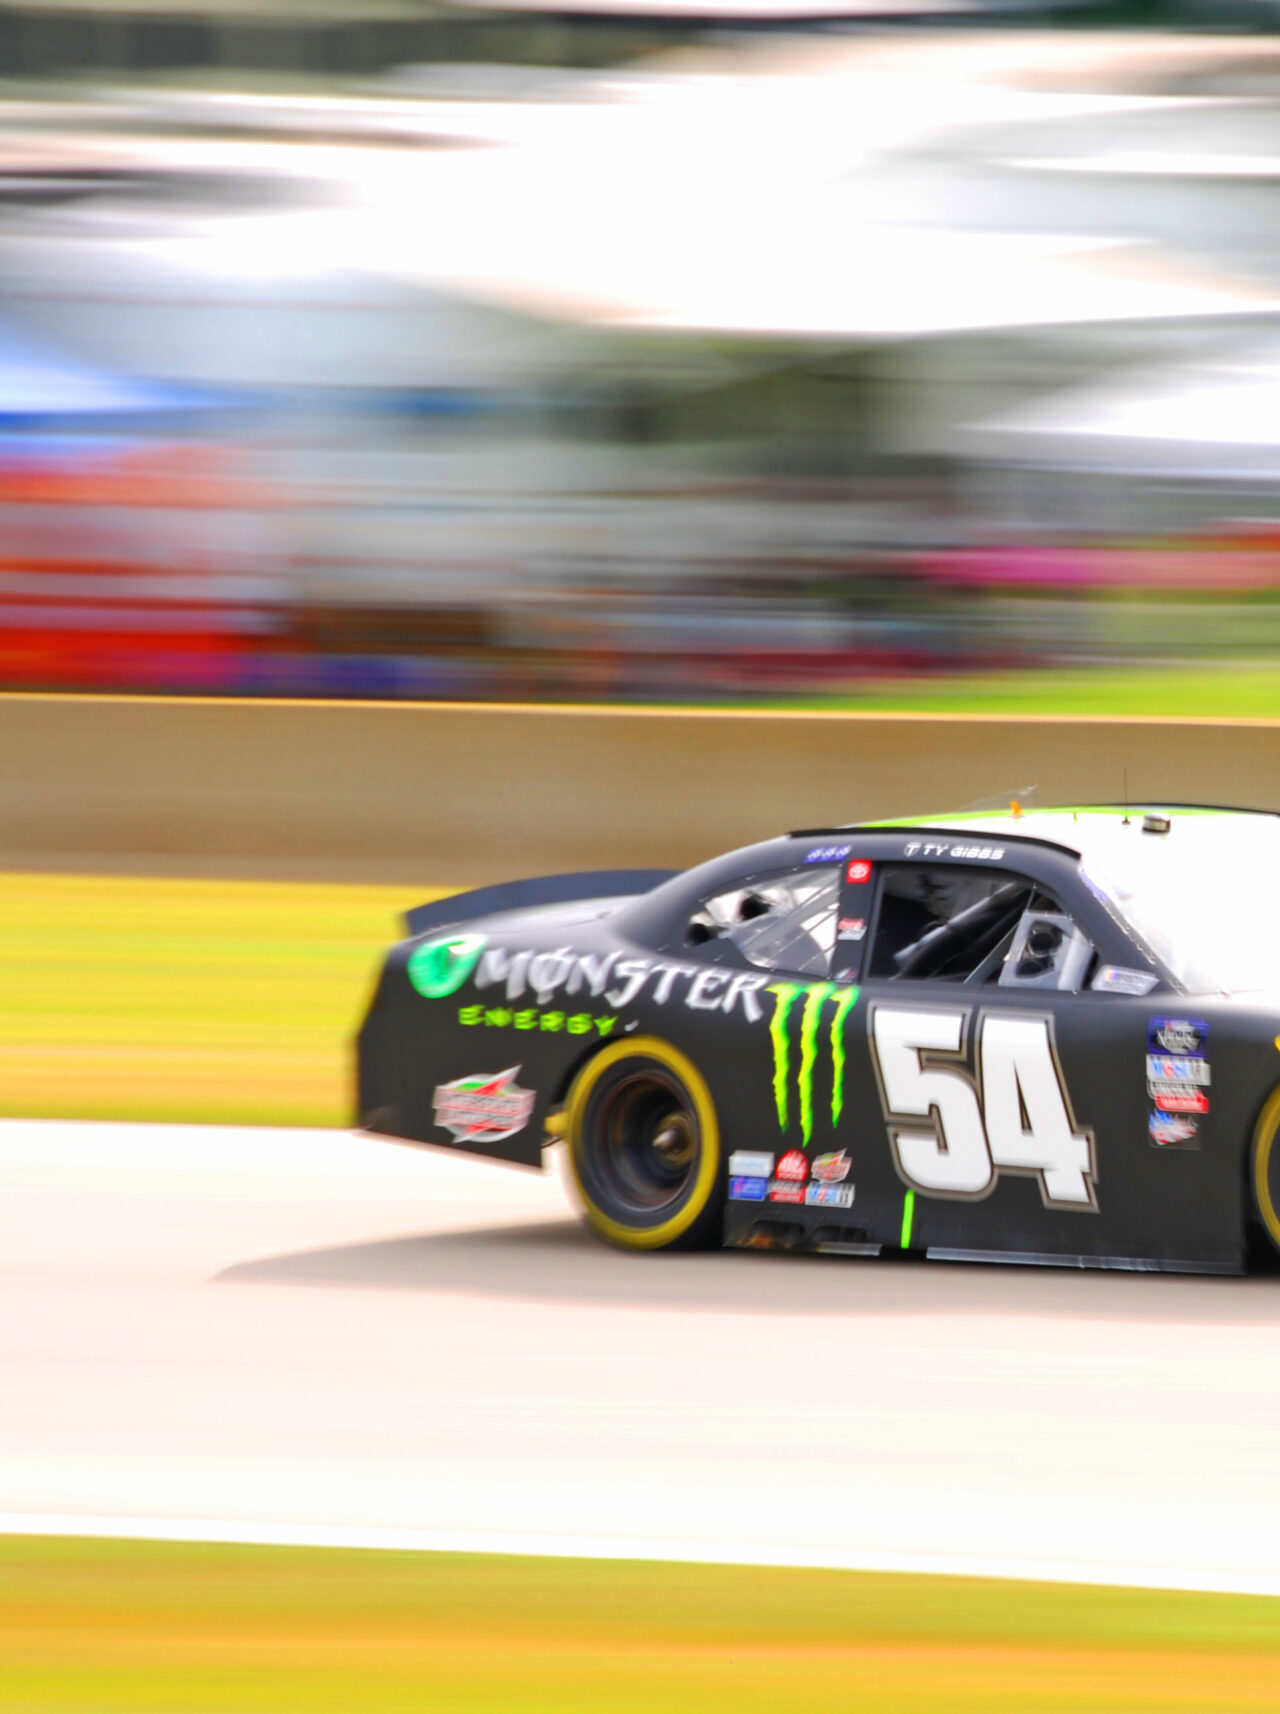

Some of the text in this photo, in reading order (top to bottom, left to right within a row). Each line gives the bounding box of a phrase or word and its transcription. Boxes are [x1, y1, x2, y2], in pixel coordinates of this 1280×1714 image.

[923, 843, 949, 857] TY
[474, 945, 770, 1023] MONSTER
[458, 1004, 619, 1036] ENERGY
[868, 1001, 1099, 1213] 54
